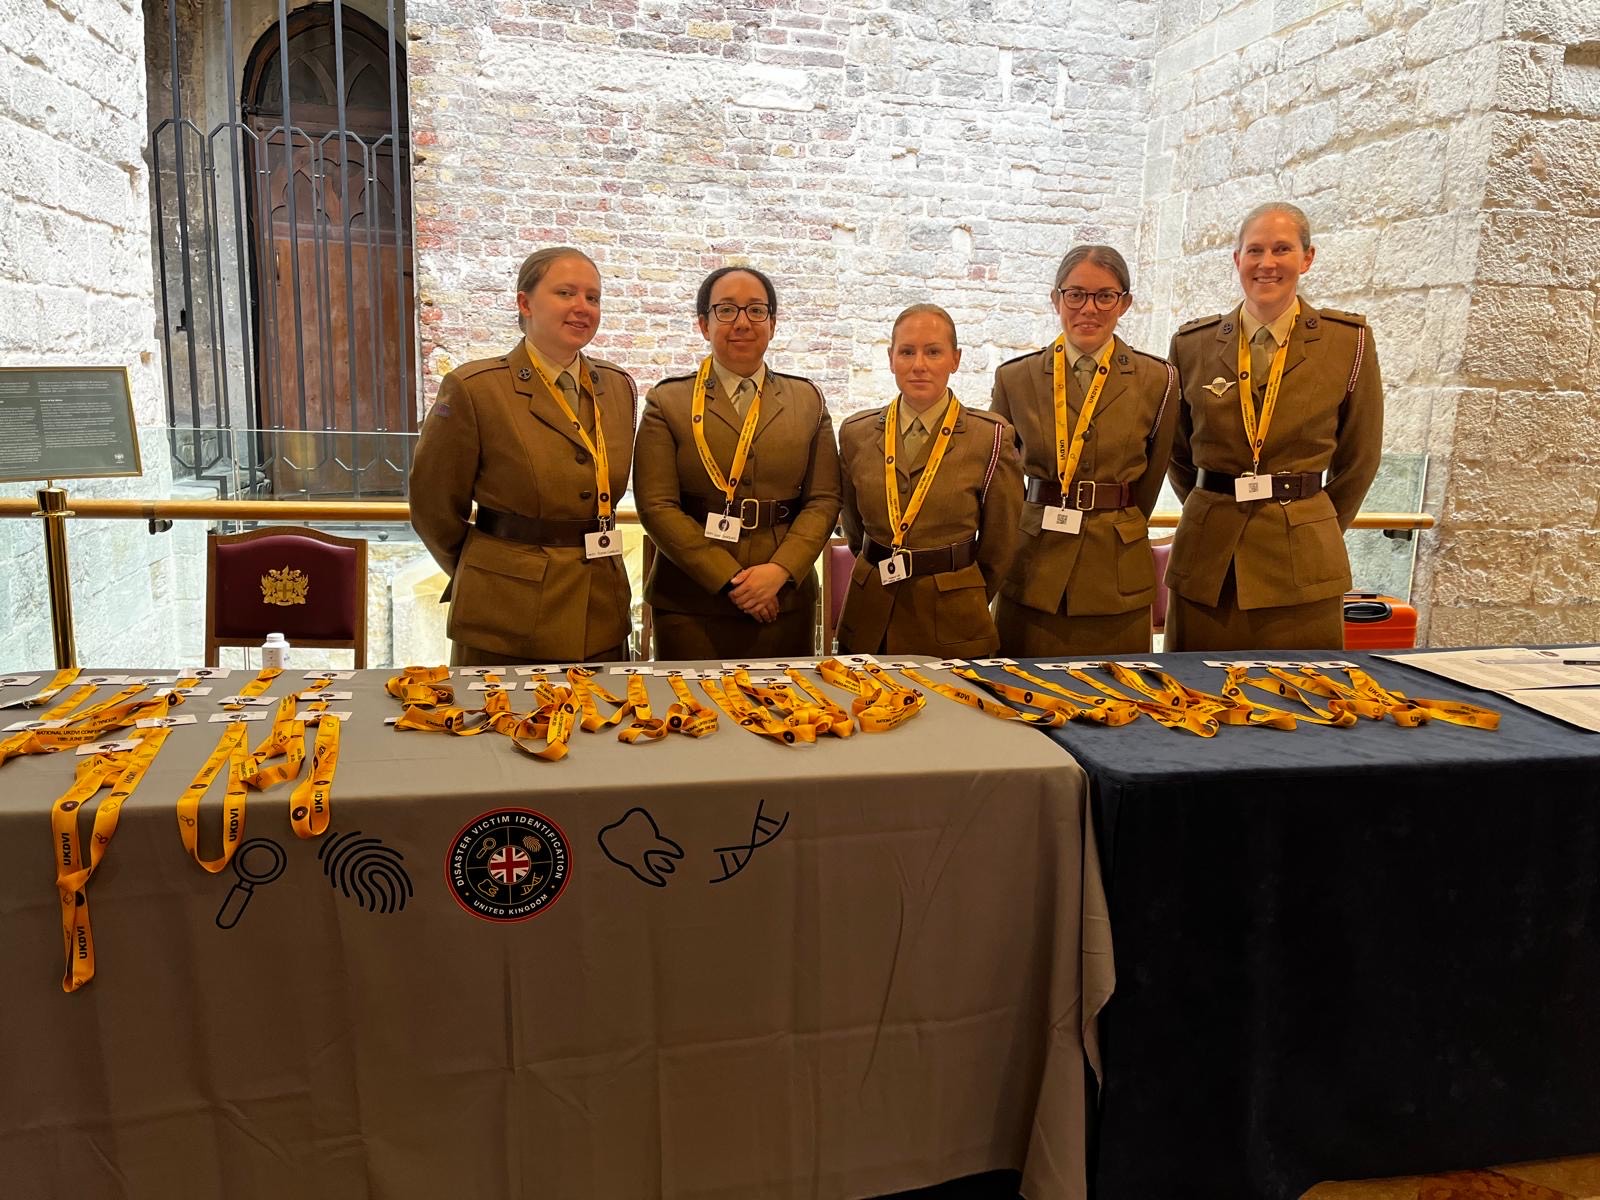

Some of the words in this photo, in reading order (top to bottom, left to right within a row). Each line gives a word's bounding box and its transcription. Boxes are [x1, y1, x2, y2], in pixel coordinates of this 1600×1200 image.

[1089, 385, 1099, 404] UKDVI
[1367, 686, 1389, 701] UKDVI
[228, 807, 239, 842] UKDVI
[61, 832, 71, 866] UKDVI
[454, 836, 472, 887] DISASTER
[472, 816, 510, 835] VICTIM
[515, 816, 565, 879] IDENTIFICATION
[473, 899, 505, 915] UNITED
[508, 893, 548, 915] KINGDOM
[76, 925, 88, 960] UKDVI
